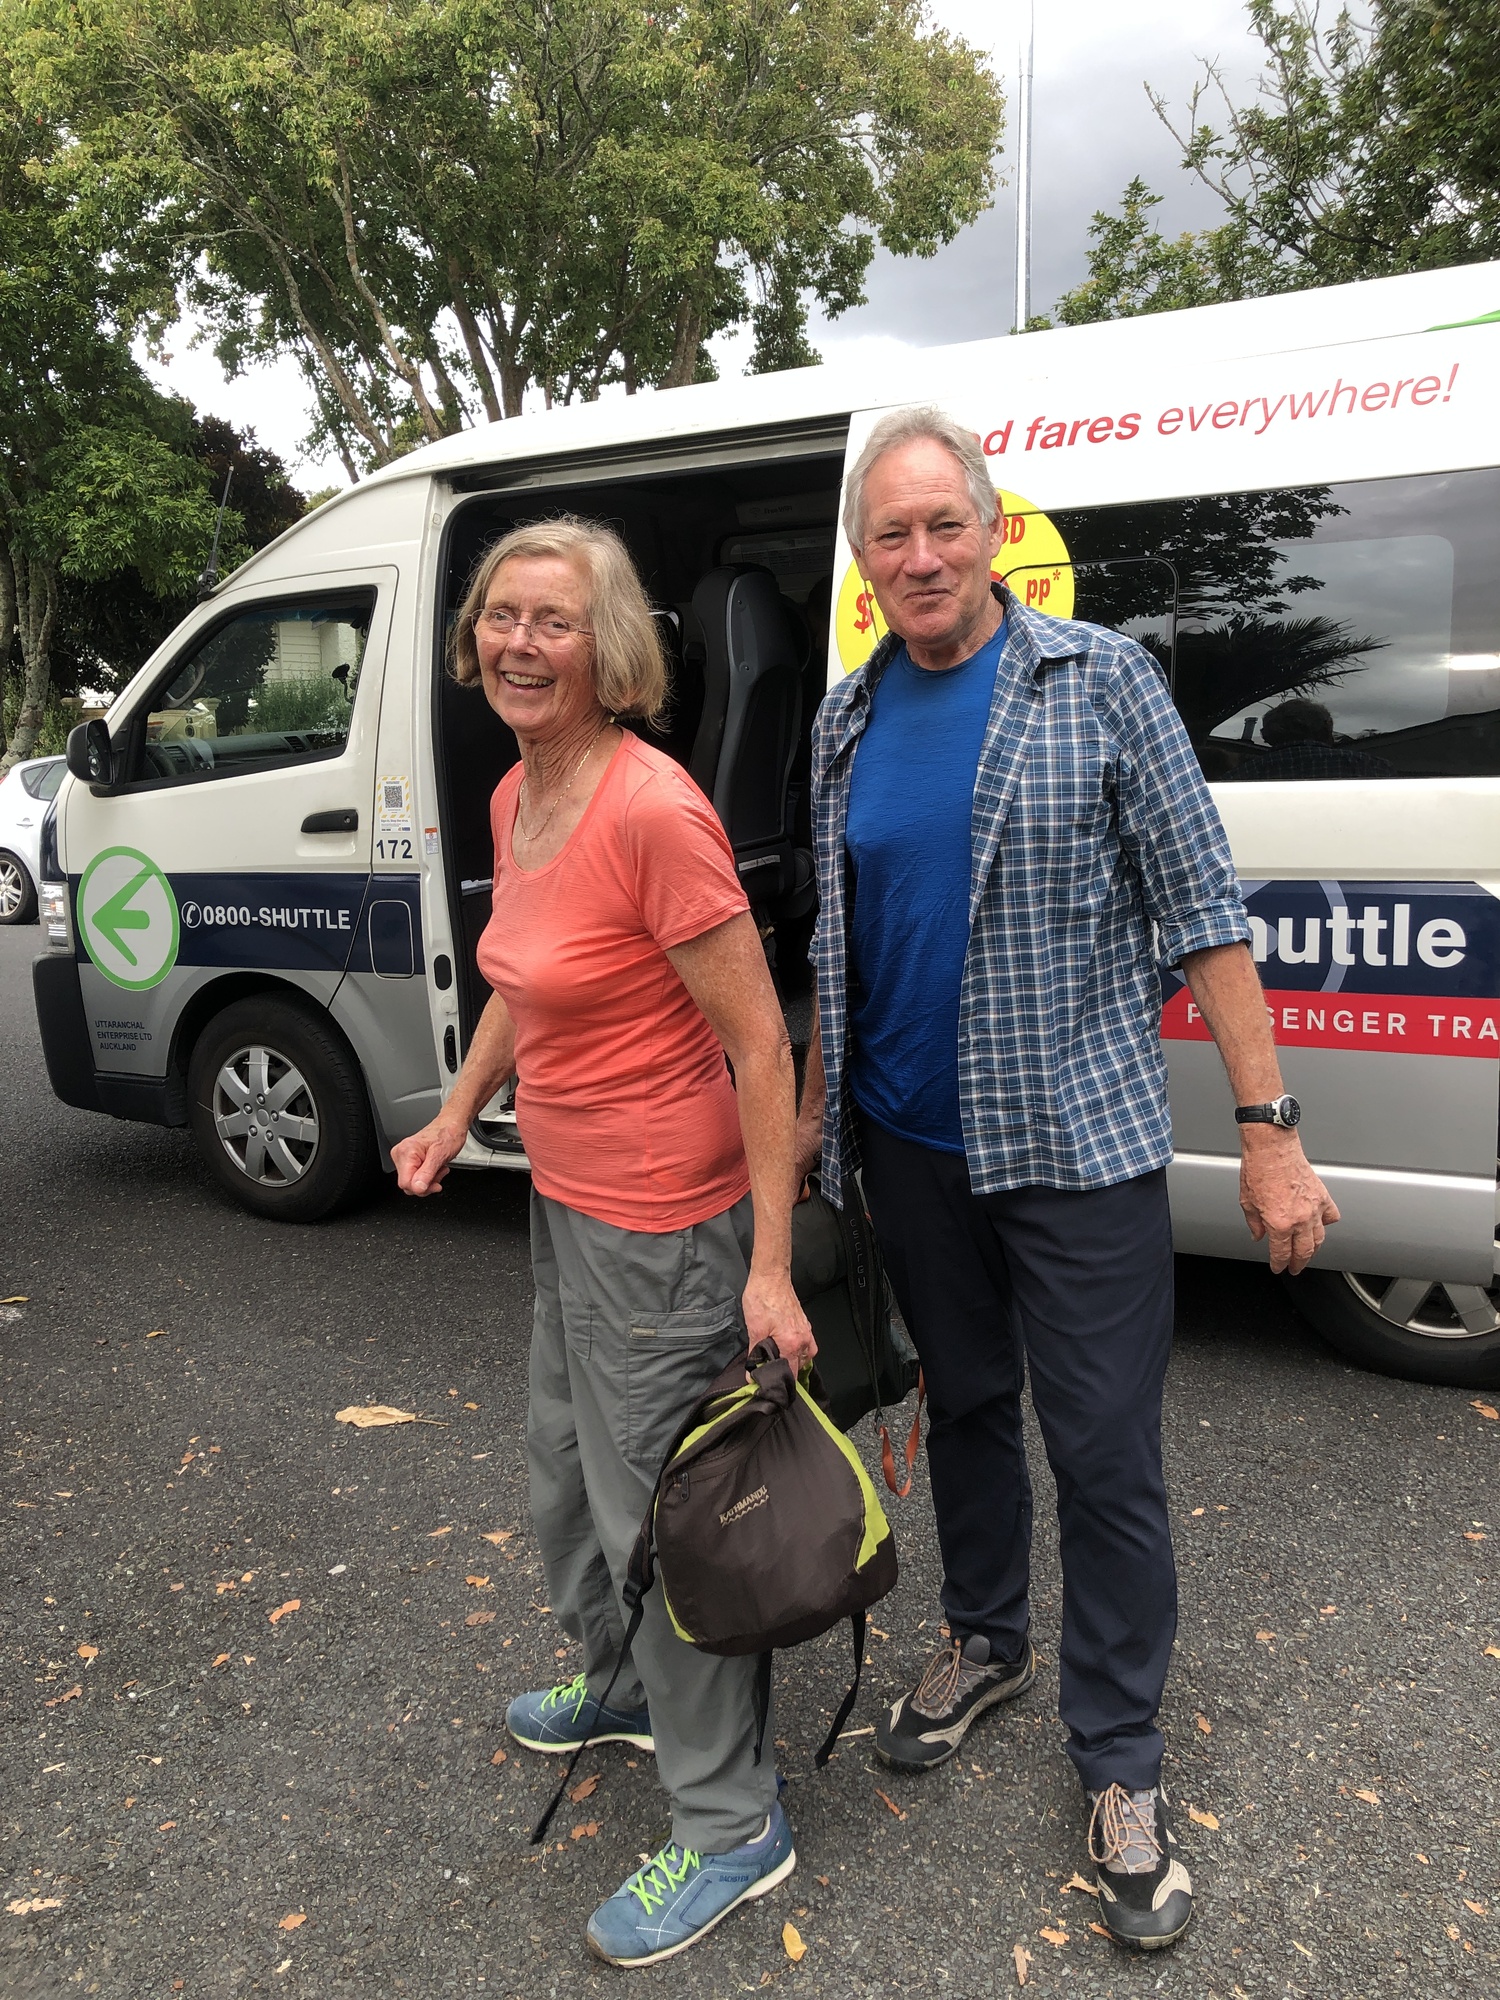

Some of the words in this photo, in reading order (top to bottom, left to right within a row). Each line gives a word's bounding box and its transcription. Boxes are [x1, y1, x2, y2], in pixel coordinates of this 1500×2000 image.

[1024, 413, 1142, 452] fares
[1157, 363, 1460, 435] everywhere!
[376, 840, 413, 859] 172
[203, 905, 351, 930] 0800-SHUTTLE
[95, 1020, 145, 1029] UTTARANCHAL
[97, 1031, 139, 1040] ENTERPRISE
[140, 1033, 153, 1041] LTD
[100, 1042, 137, 1051] AUCKLAND
[719, 1485, 768, 1524] KATHMANDU
